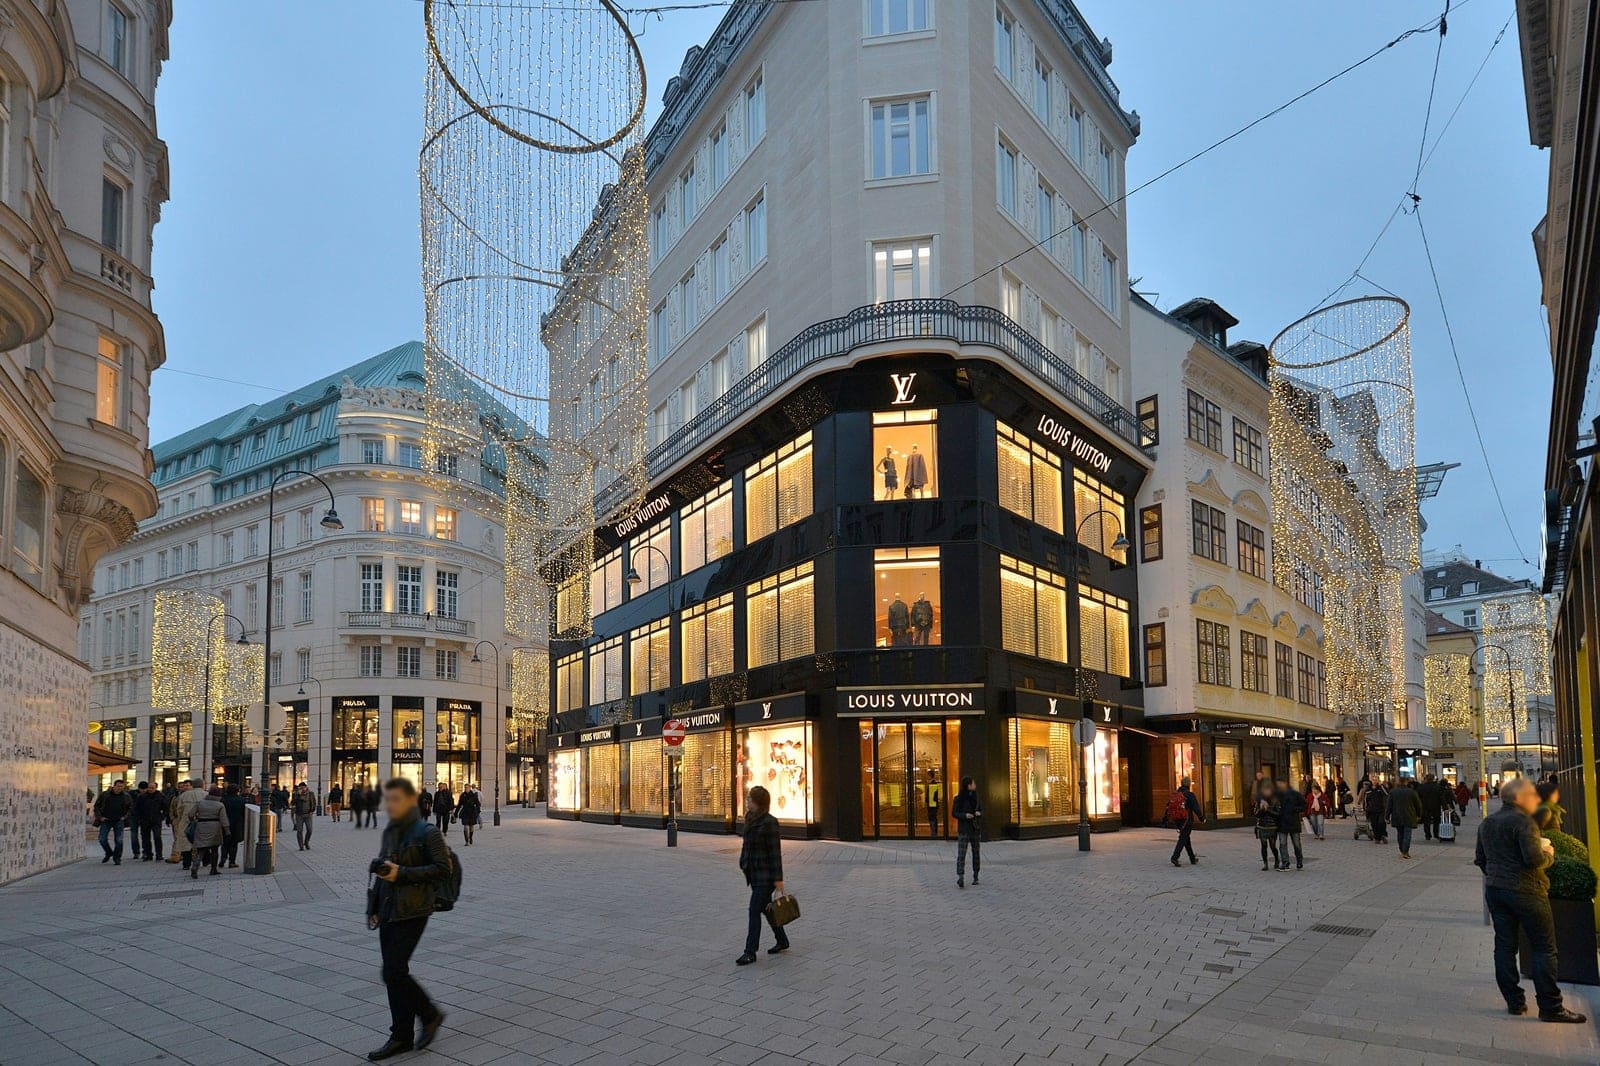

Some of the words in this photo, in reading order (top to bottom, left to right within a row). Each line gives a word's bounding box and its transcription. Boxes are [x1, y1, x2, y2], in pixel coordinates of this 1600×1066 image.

[1037, 414, 1071, 447] LOUIS
[1070, 435, 1112, 473] VUITTON
[615, 516, 638, 538] LOUIS
[635, 493, 671, 524] VUITTON
[848, 694, 896, 709] LOUIS
[900, 692, 973, 707] VUITTON
[691, 713, 720, 727] VUITTON
[580, 733, 593, 742] LOUIS
[593, 730, 611, 740] VUITTON
[1264, 727, 1285, 738] VUITTON
